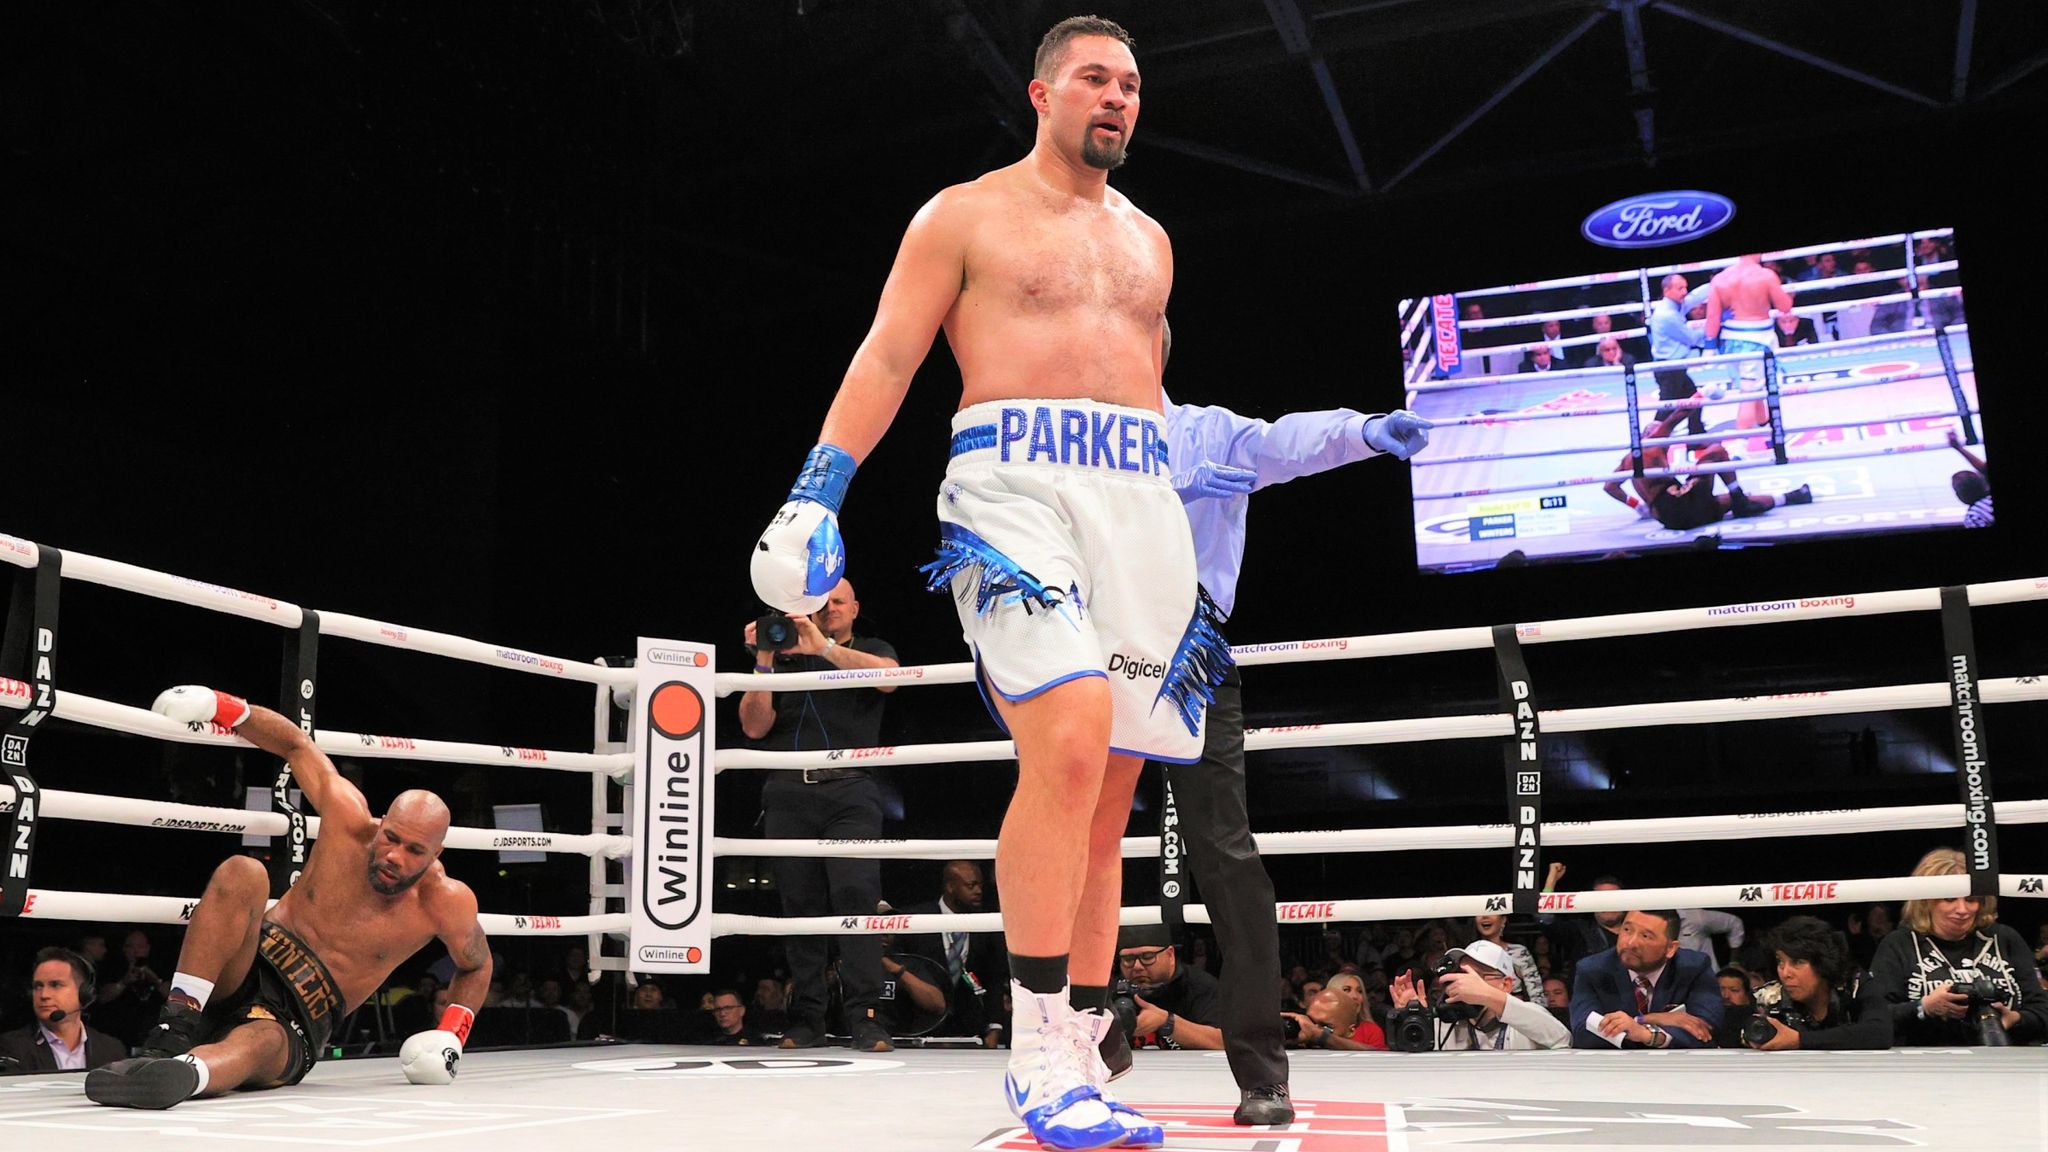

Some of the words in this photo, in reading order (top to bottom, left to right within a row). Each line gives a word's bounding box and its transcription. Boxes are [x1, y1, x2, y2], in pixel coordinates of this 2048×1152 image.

[1612, 200, 1703, 240] Ford
[1433, 293, 1459, 372] TECATE
[1000, 406, 1161, 476] PARKER
[1708, 600, 1796, 616] matchroom
[1800, 596, 1854, 609] boxing
[652, 651, 692, 664] Winline
[1302, 640, 1348, 650] boxing
[496, 649, 539, 666] matchroom
[540, 658, 564, 673] boxing
[1108, 653, 1166, 680] Digicel
[19, 628, 53, 726] DAZN
[820, 670, 881, 680] matchroom
[885, 668, 924, 678] boxing
[1511, 681, 1536, 760] DAZN
[1952, 655, 1990, 870] matchroomboxing.com
[10, 775, 35, 878] DAZN
[658, 751, 690, 905] Winline
[1518, 806, 1536, 889] DAZN
[1538, 895, 1576, 910] CATE
[1771, 883, 1838, 900] TECATE
[864, 916, 912, 930] TECATE
[1279, 903, 1335, 919] TECATE
[644, 949, 685, 960] Winline
